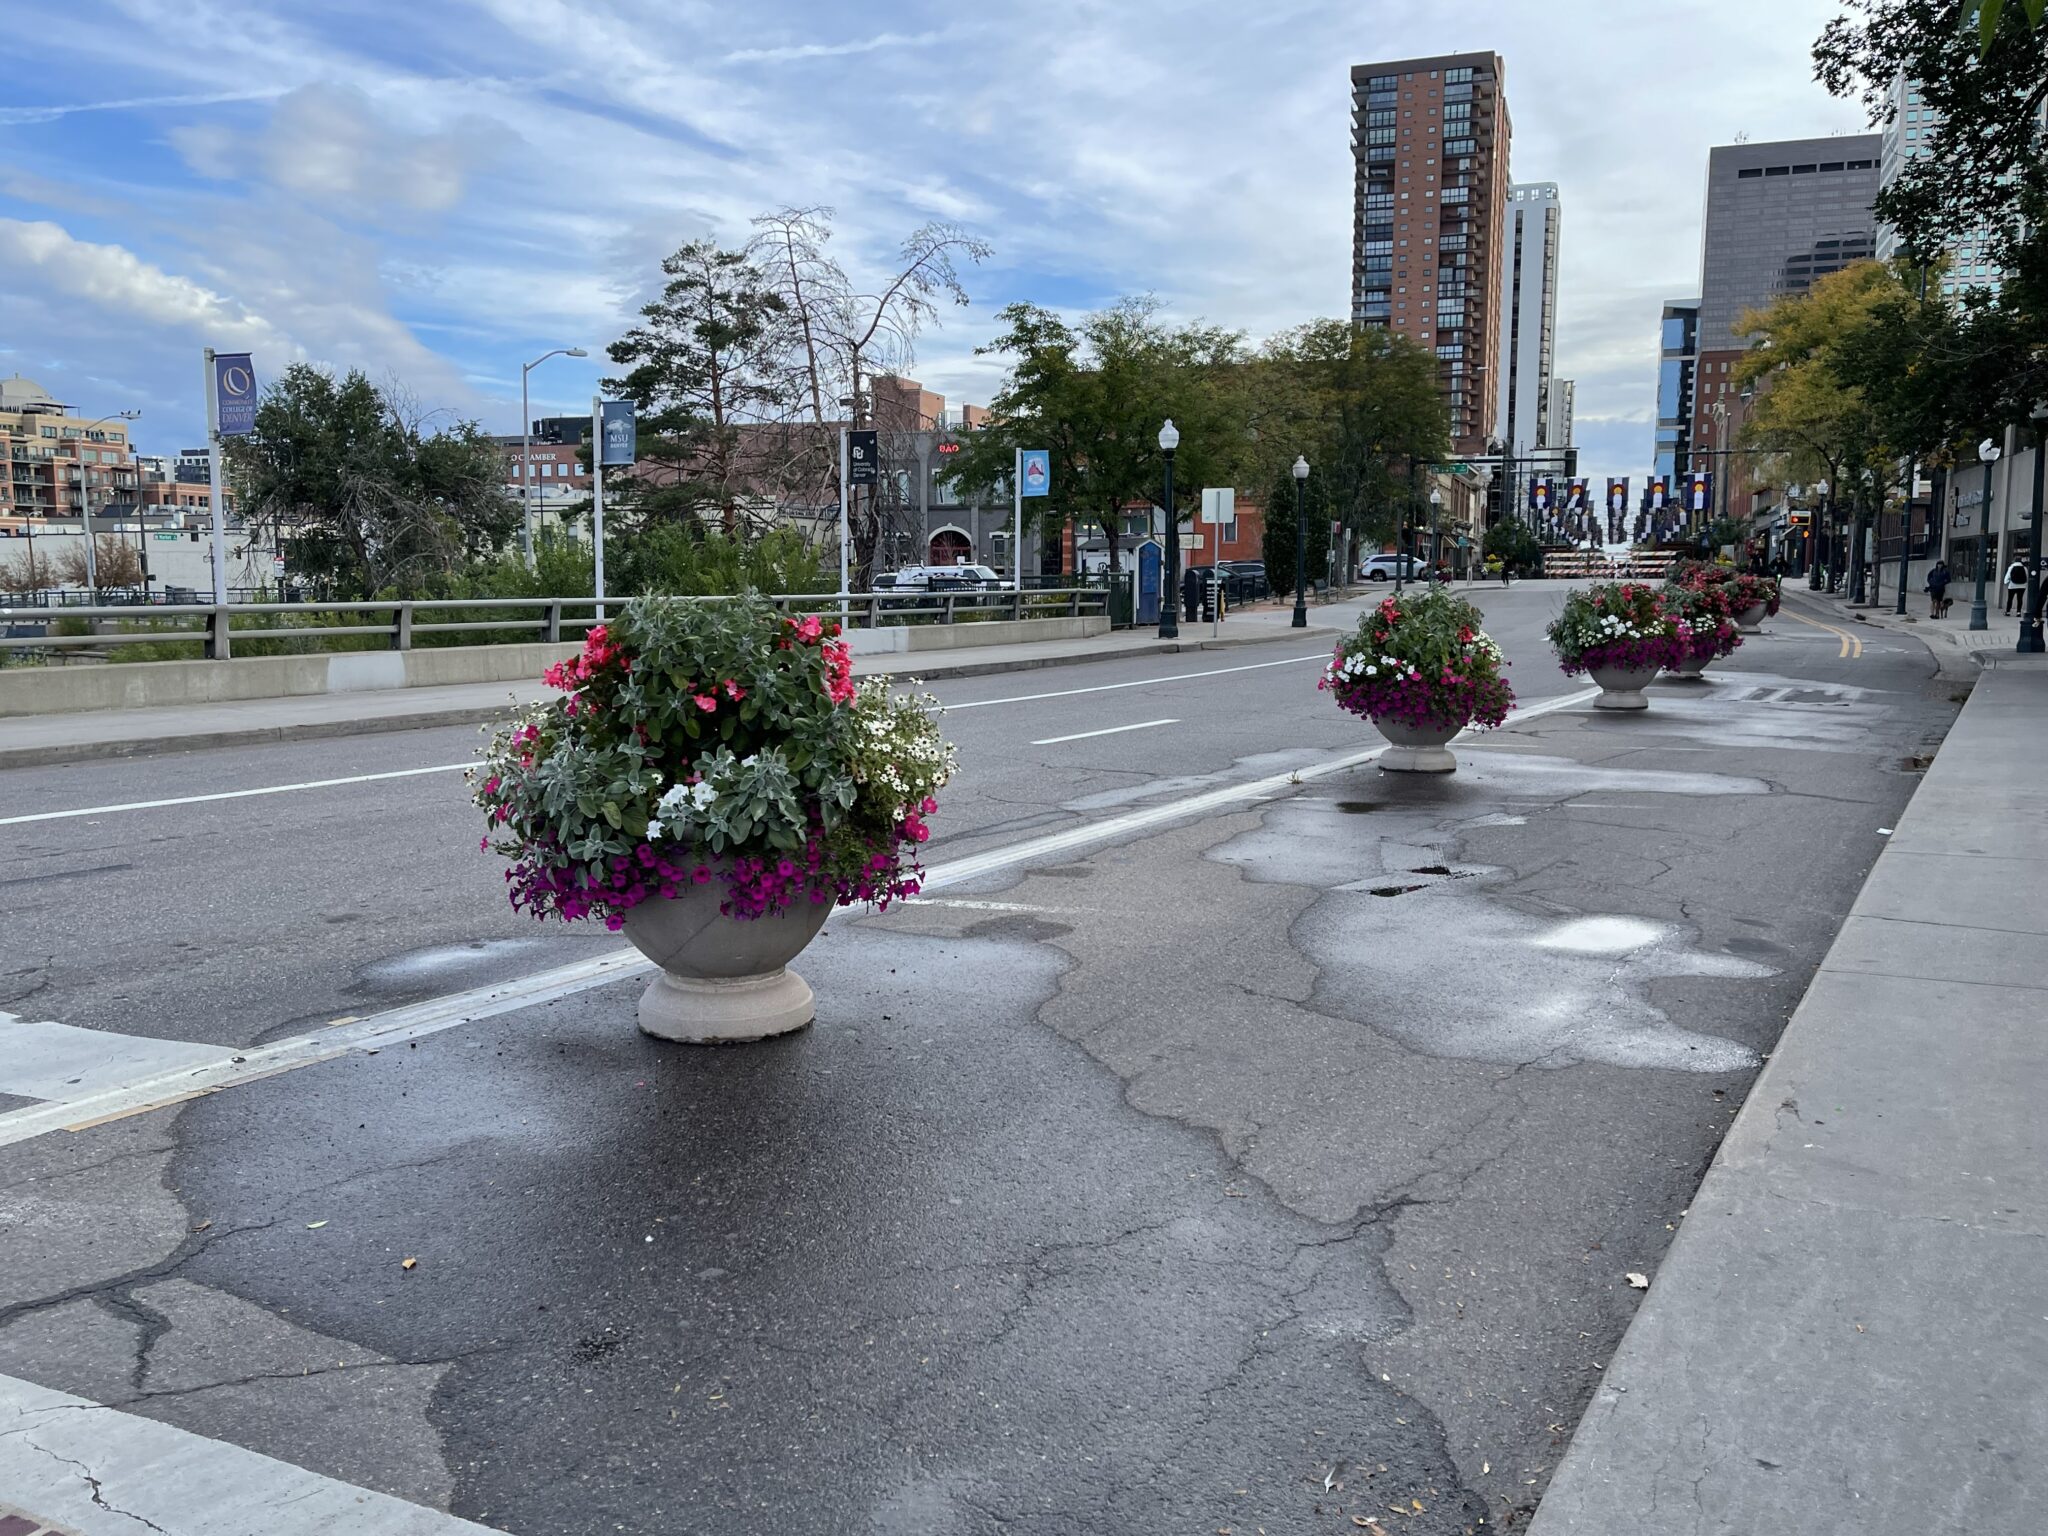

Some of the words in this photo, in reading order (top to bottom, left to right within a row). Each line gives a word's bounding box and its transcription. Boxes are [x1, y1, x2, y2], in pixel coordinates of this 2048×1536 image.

[222, 413, 252, 422] DENVER
[610, 434, 628, 443] MSU
[518, 453, 557, 461] CAMBER
